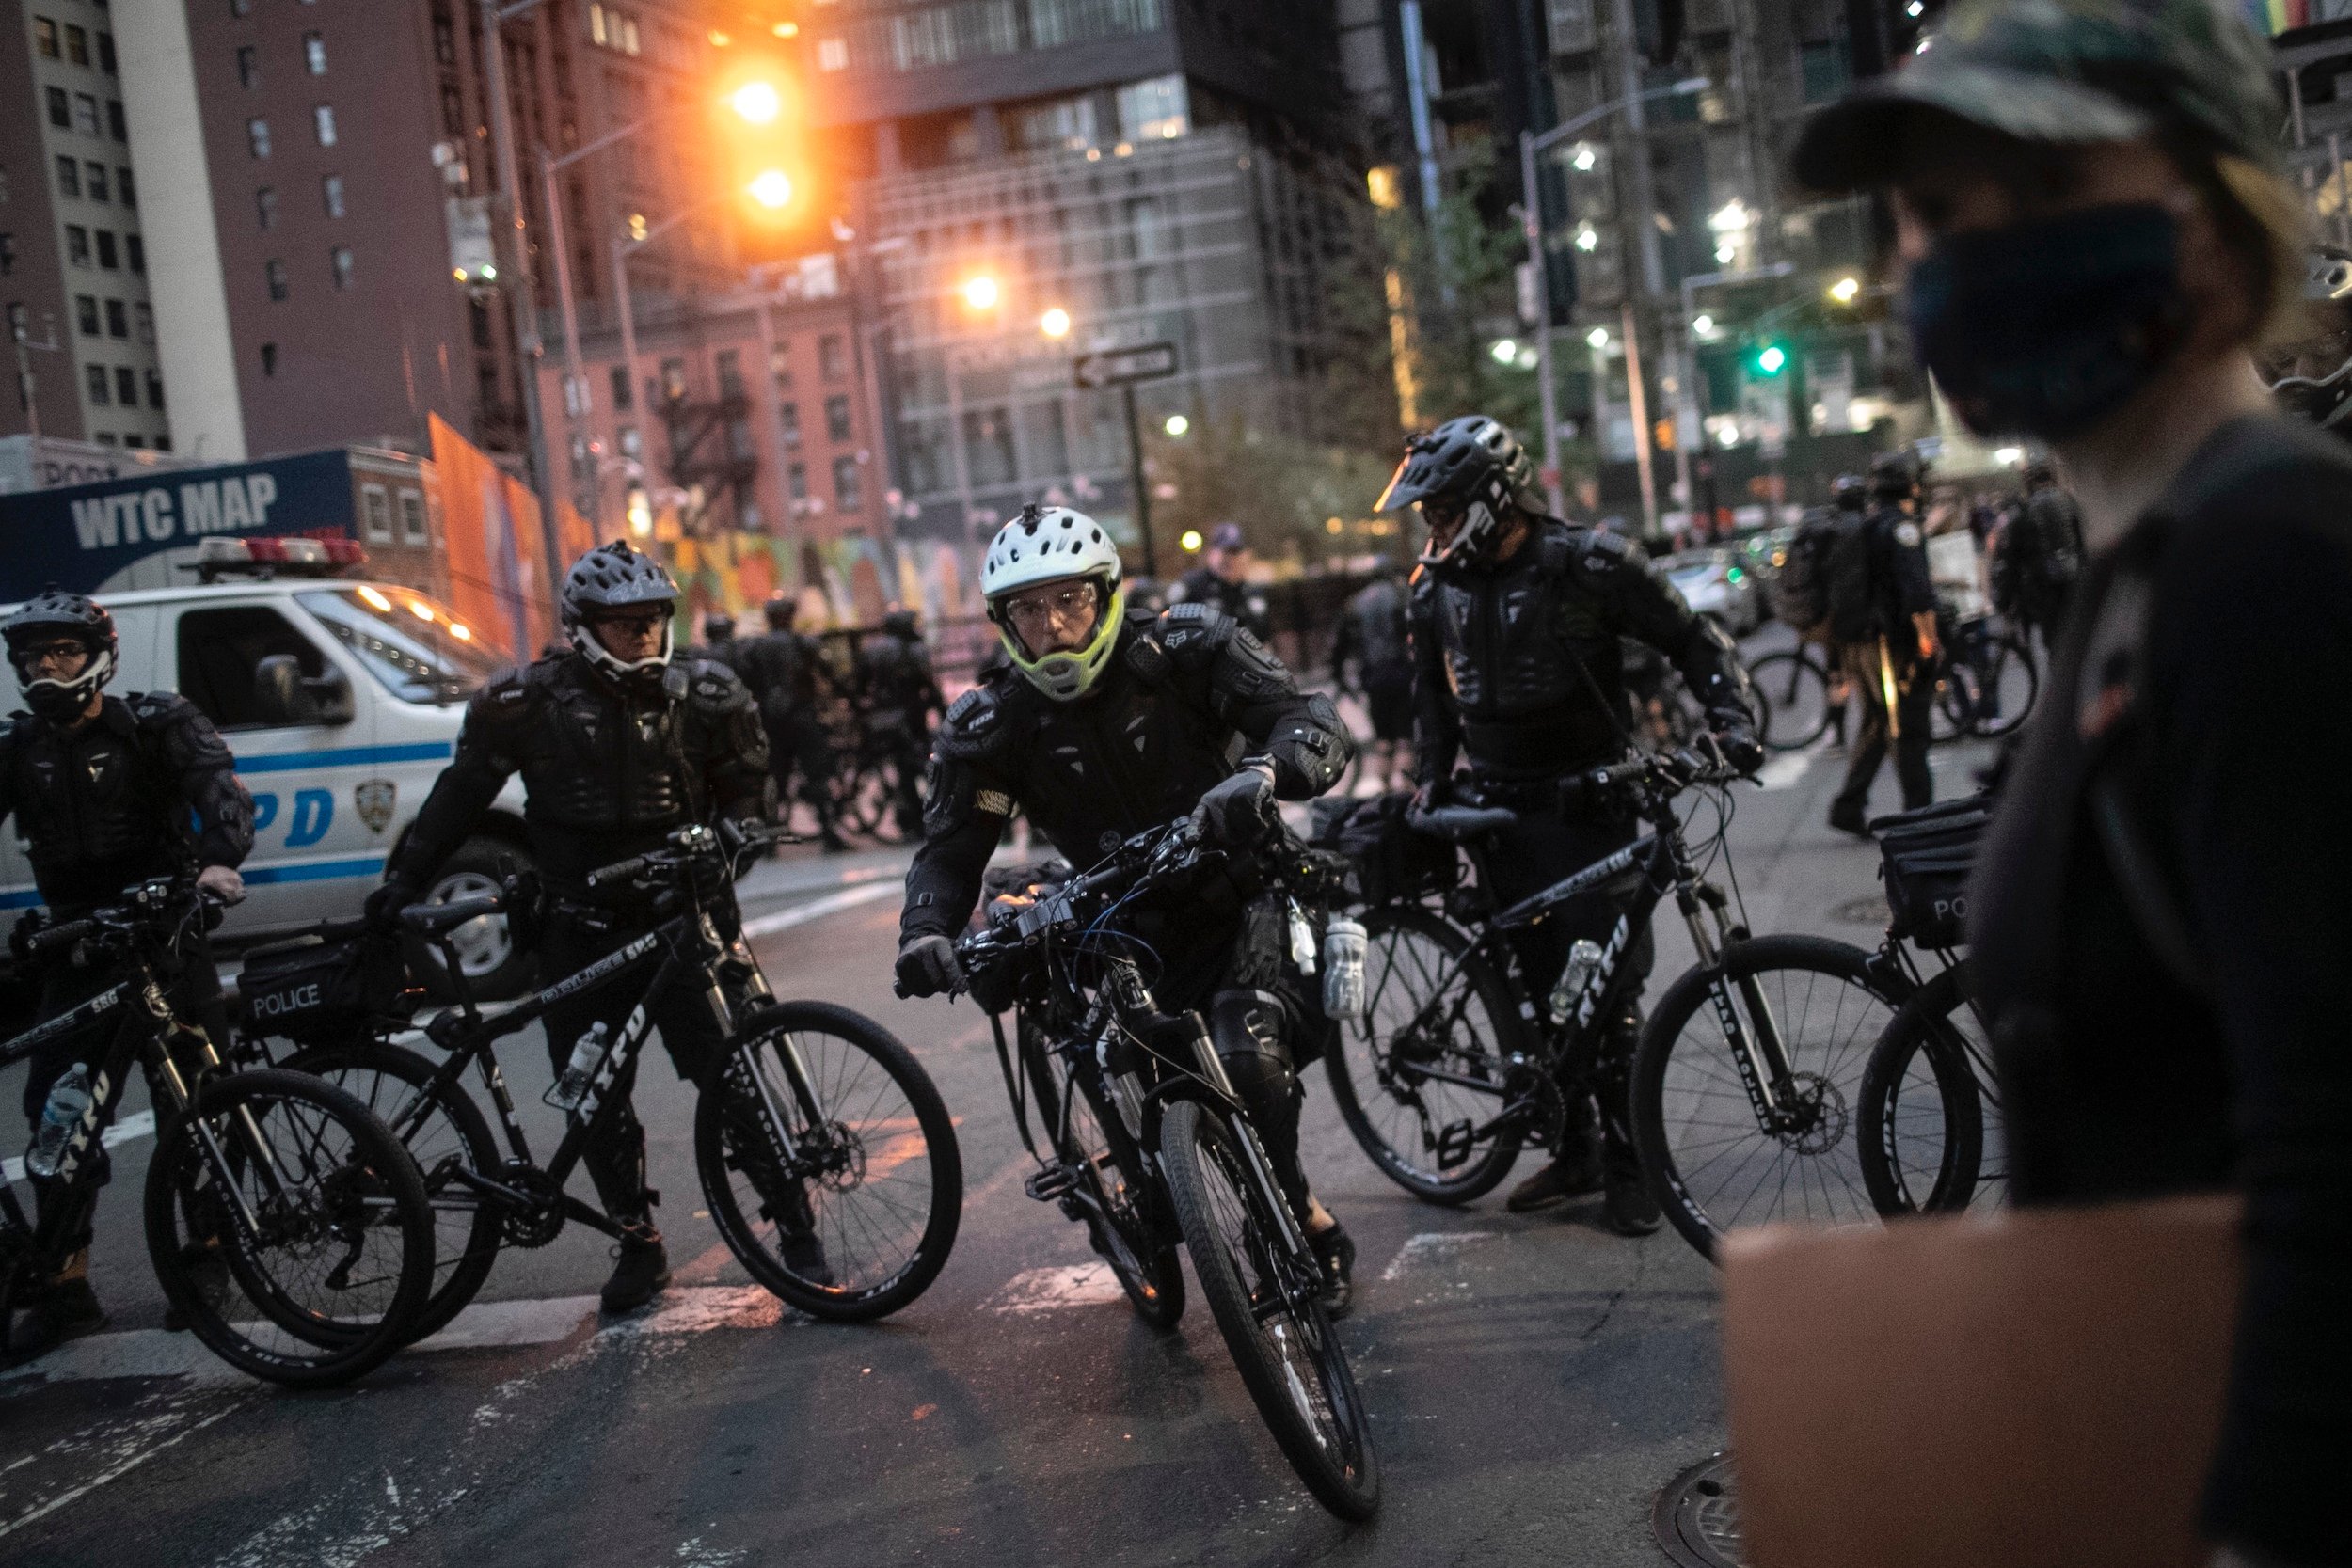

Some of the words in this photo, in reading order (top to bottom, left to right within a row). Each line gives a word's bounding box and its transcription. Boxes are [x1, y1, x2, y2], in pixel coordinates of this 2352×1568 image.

[71, 487, 175, 549] WTC
[180, 473, 278, 535] MAP
[968, 710, 994, 731] FOX
[89, 989, 120, 1014] SRG
[253, 983, 321, 1019] POLICE
[577, 1002, 645, 1126] NYPD
